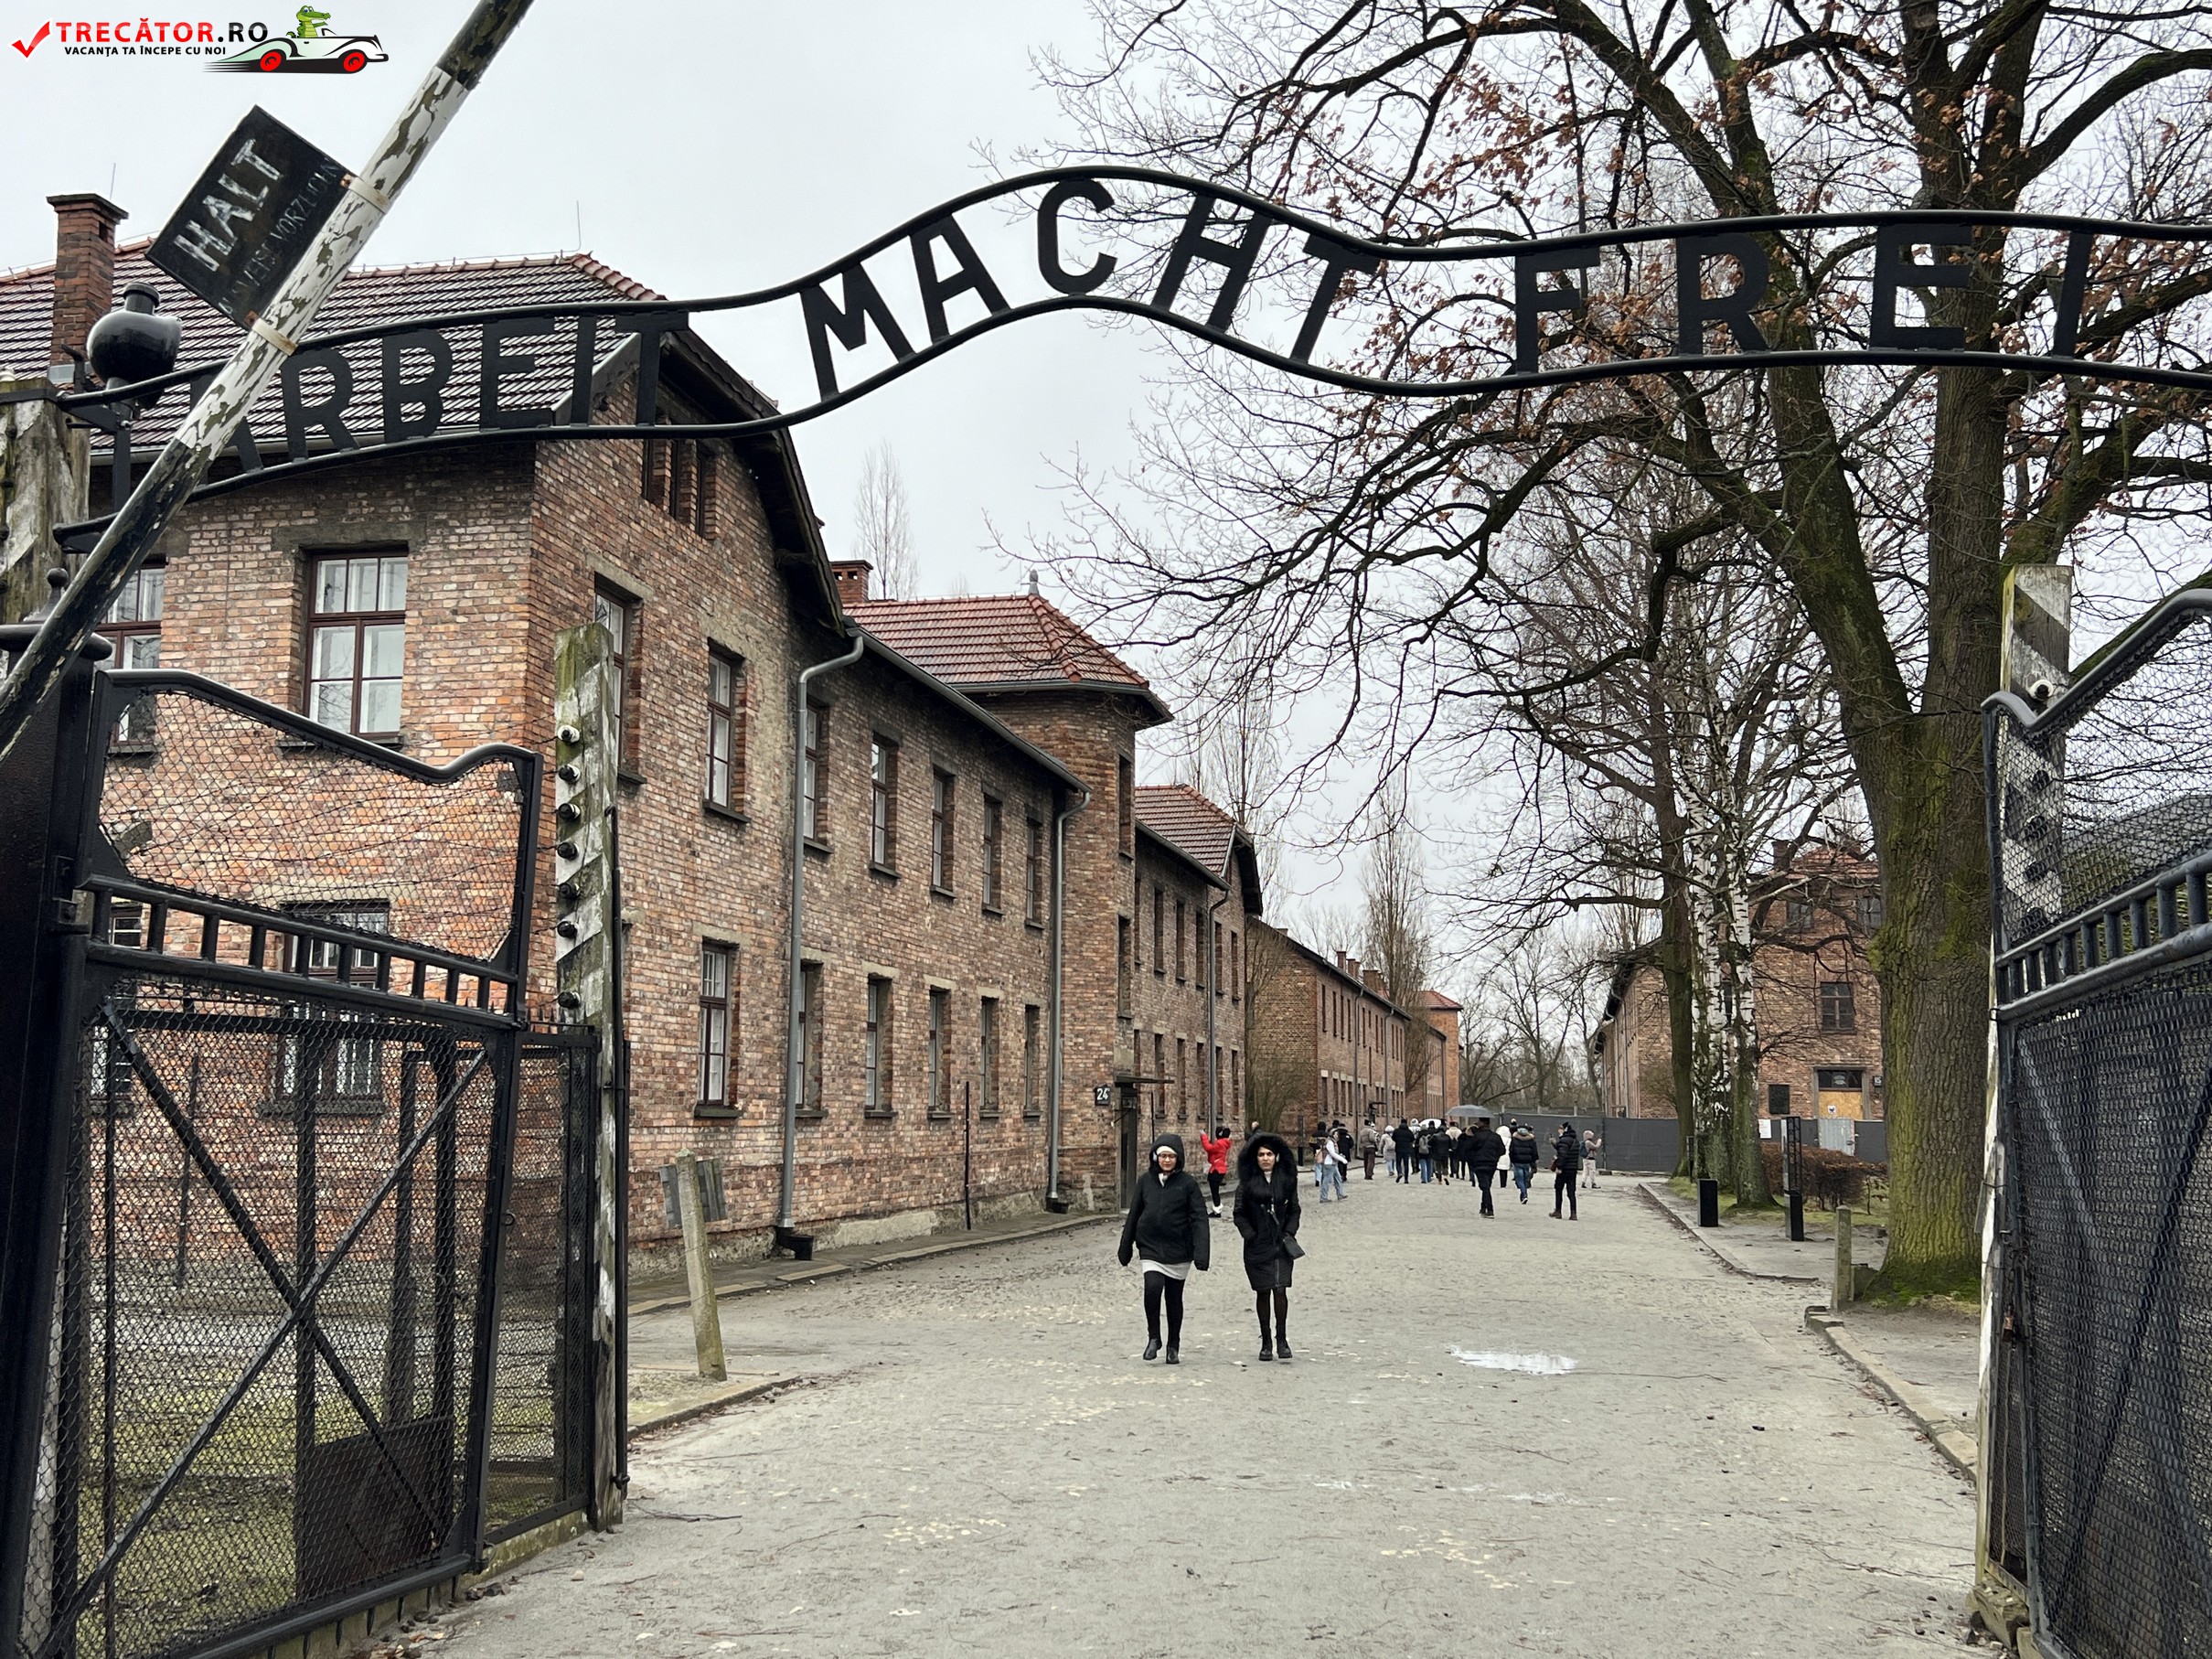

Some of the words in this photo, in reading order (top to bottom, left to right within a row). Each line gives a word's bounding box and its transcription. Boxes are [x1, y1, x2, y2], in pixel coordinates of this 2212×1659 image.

[173, 138, 284, 273] HALT
[798, 178, 1382, 402] MACHT
[1514, 223, 2095, 374] FREI
